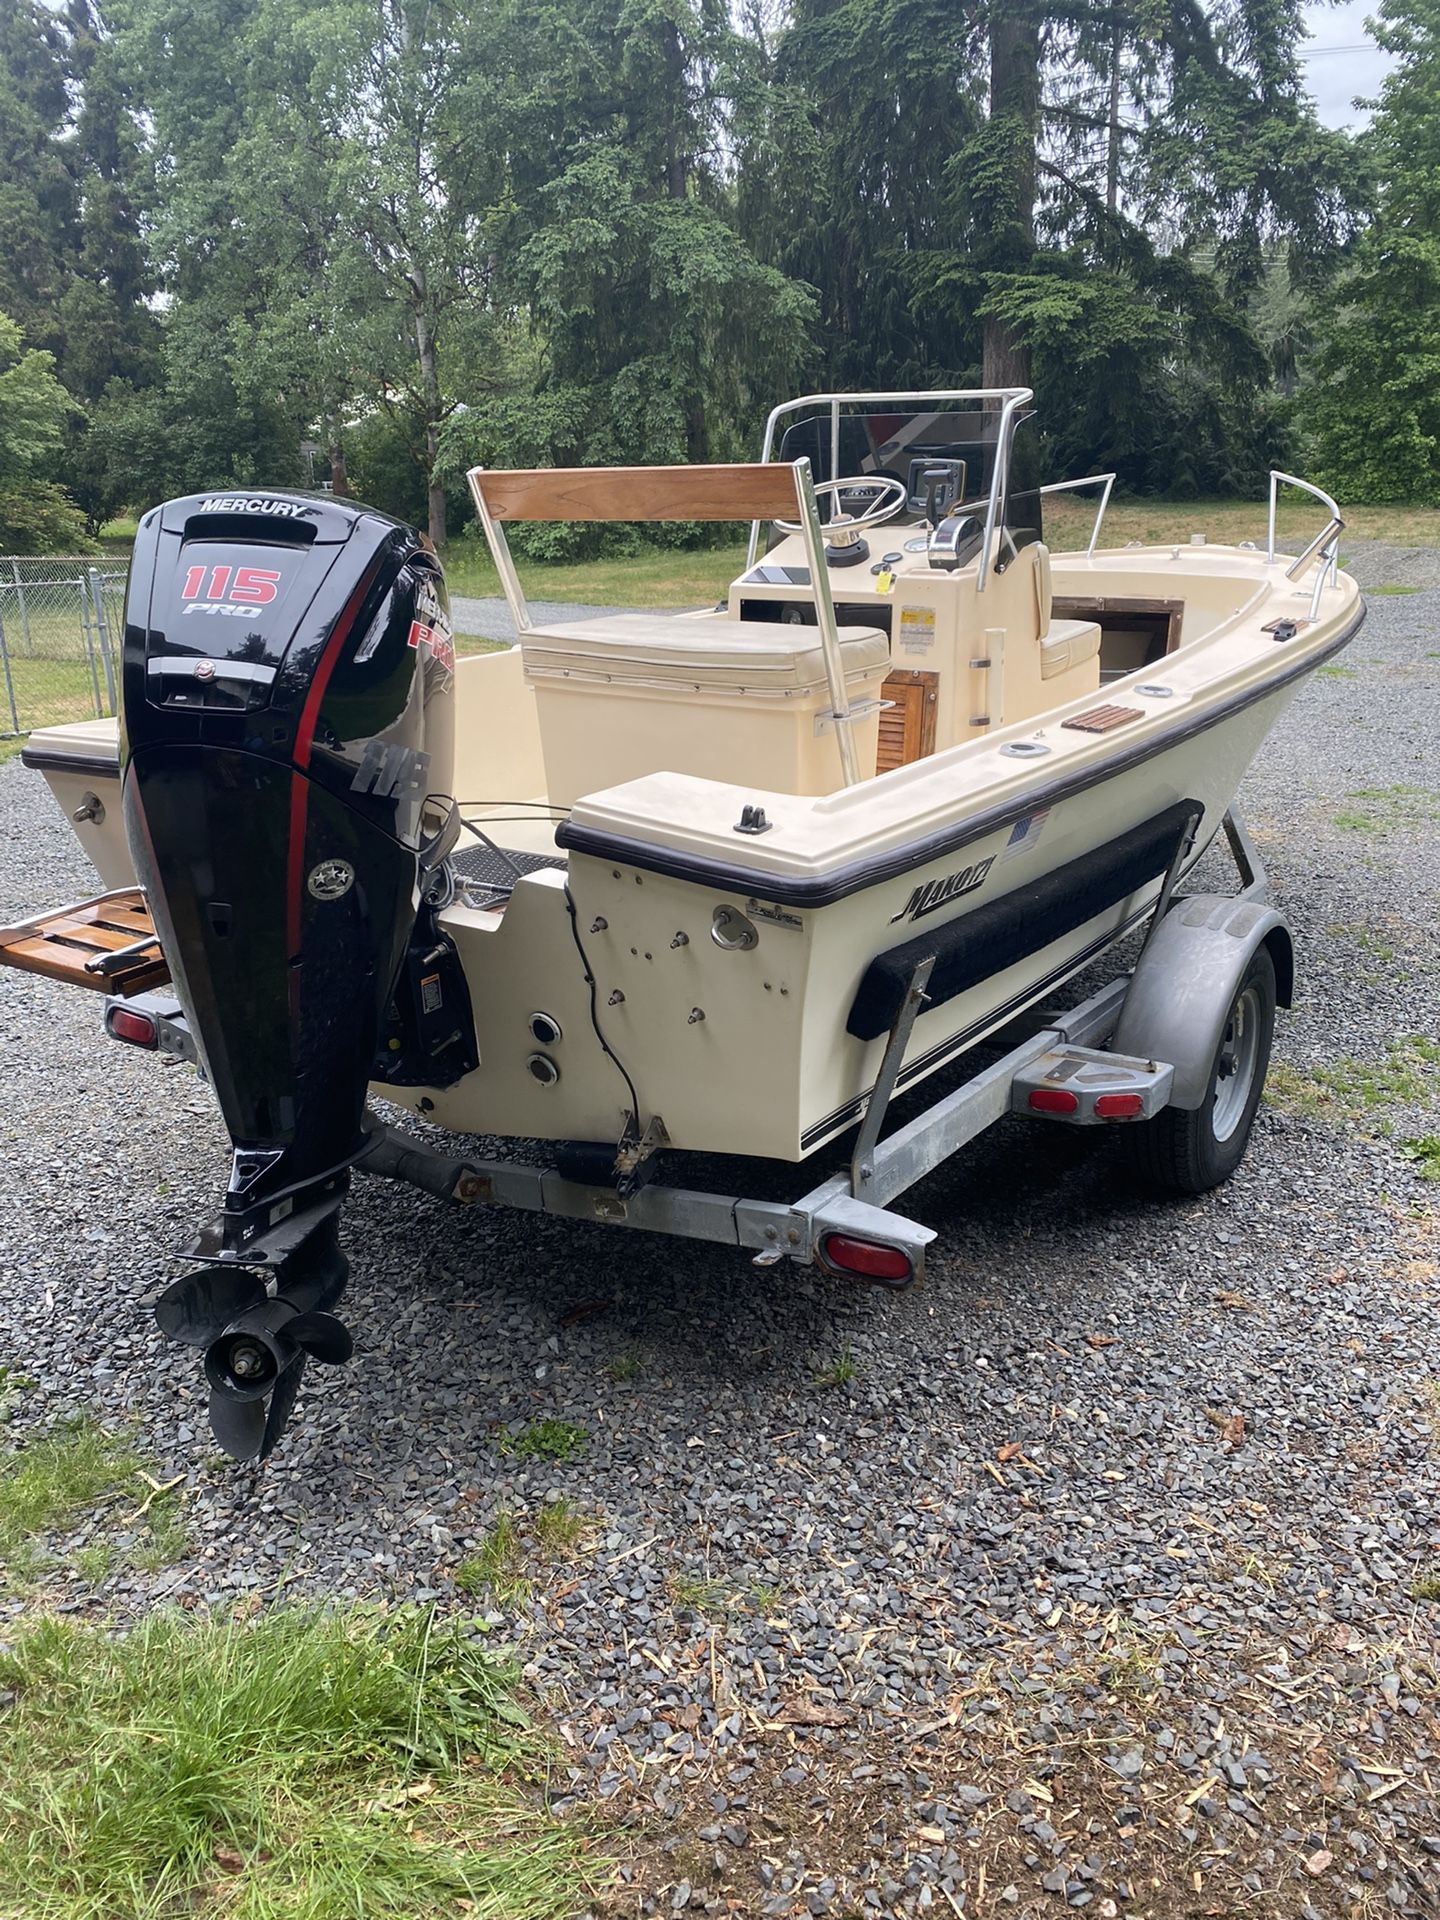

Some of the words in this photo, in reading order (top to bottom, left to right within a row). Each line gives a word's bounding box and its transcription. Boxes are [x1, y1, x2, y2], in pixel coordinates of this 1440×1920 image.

[200, 498, 307, 517] MERCURY
[181, 566, 281, 604] 115
[182, 603, 263, 618] PRO
